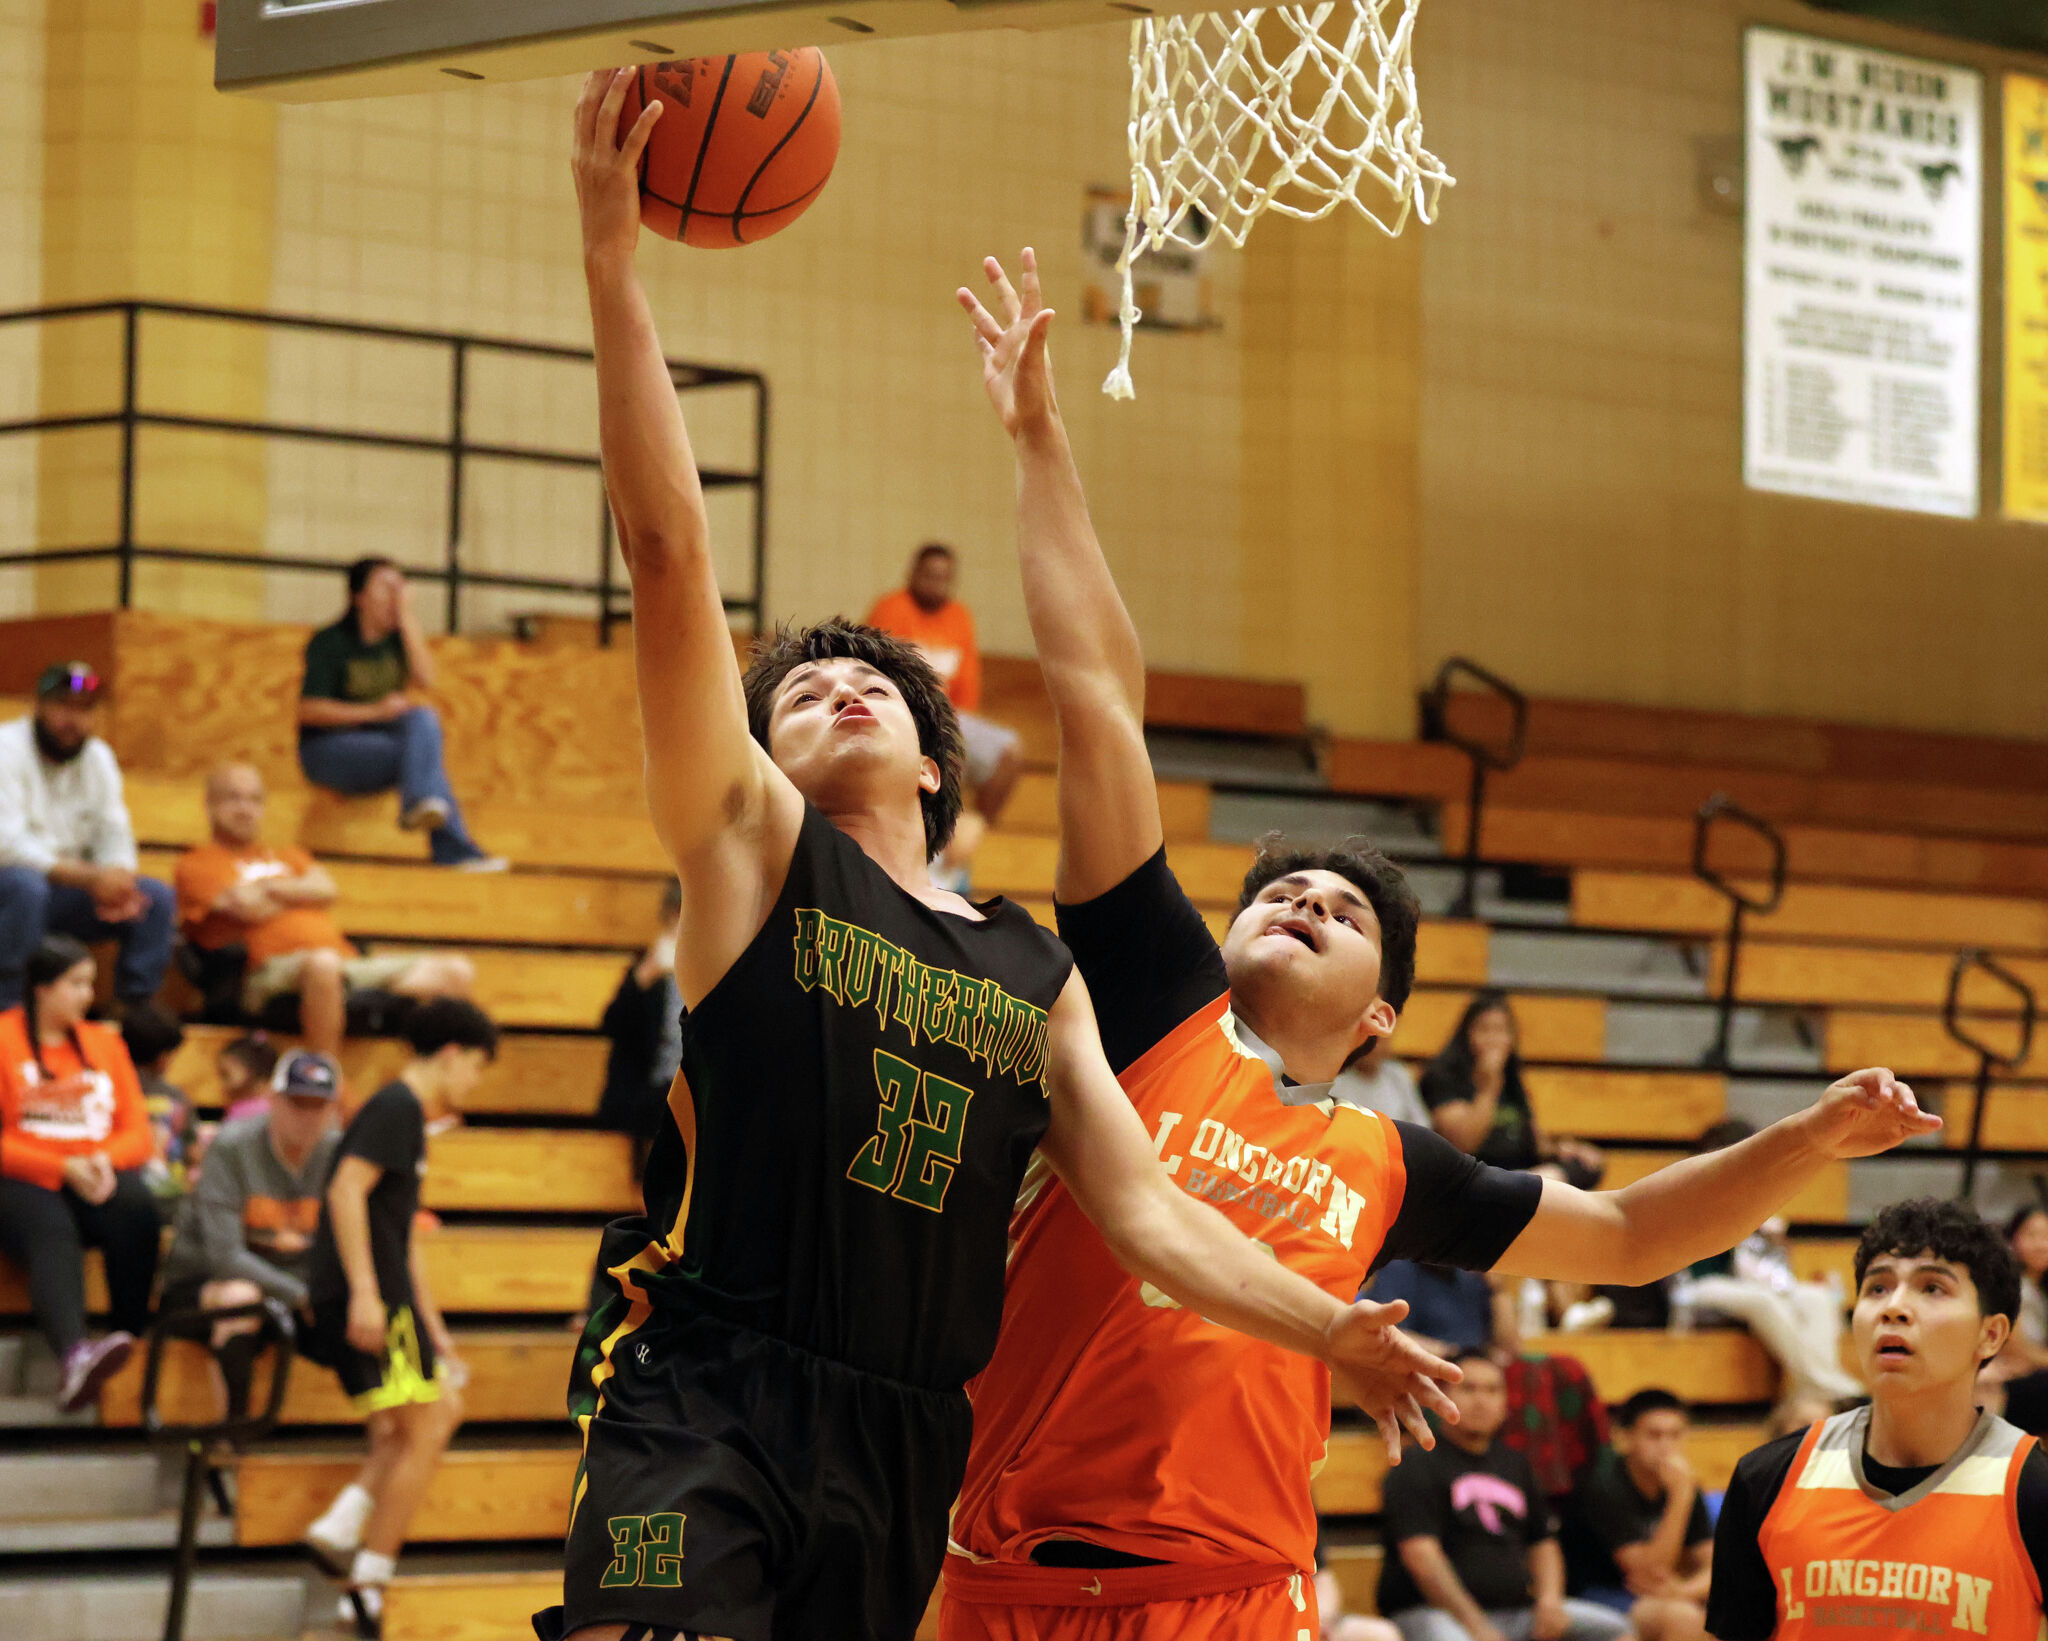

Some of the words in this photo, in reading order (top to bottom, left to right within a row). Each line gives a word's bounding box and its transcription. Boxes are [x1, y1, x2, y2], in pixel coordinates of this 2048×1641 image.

[794, 908, 1050, 1098] BROTHERHOO
[847, 1048, 974, 1213] 32
[1154, 1111, 1367, 1252] LONGHORN
[600, 1512, 687, 1588] 32
[1780, 1559, 1993, 1635] LONGHORN
[1813, 1605, 1945, 1635] BASKETBALL
